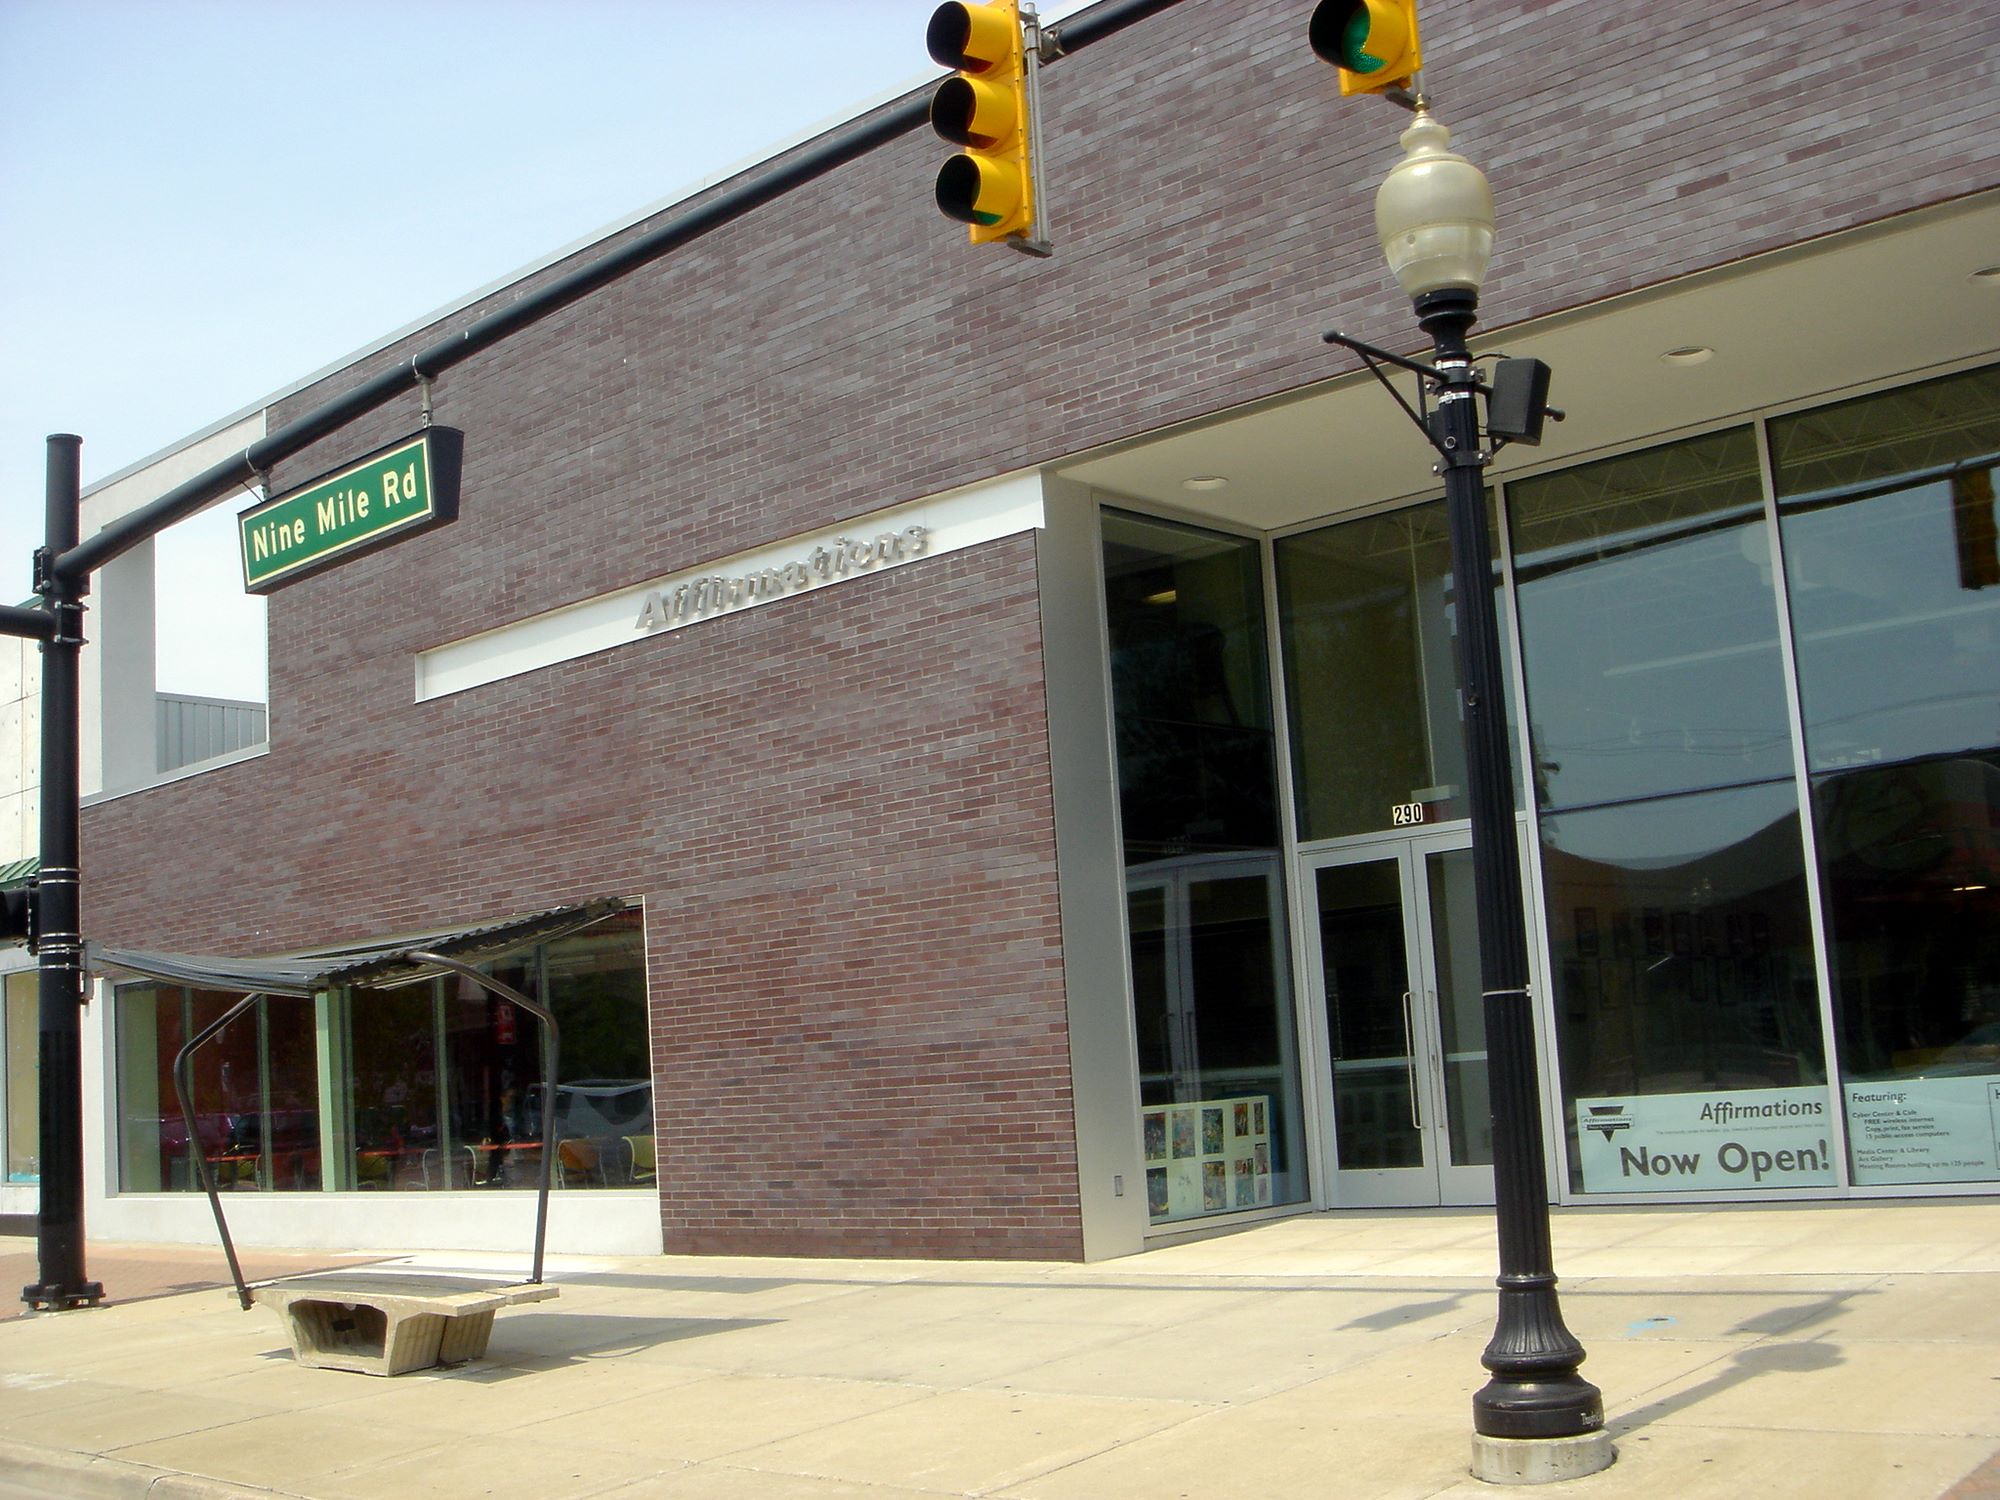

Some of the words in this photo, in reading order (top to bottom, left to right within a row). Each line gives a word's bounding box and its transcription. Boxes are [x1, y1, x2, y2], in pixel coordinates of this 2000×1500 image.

[252, 518, 305, 562] Nine
[317, 489, 369, 535] Mile
[383, 462, 417, 508] Rd
[634, 525, 928, 631] Affirmations
[1394, 803, 1422, 824] 290
[1700, 1099, 1823, 1125] Affirmations
[1852, 1091, 1907, 1104] Featuring:
[1620, 1146, 1700, 1177] Now
[1717, 1138, 1830, 1182] Open!
